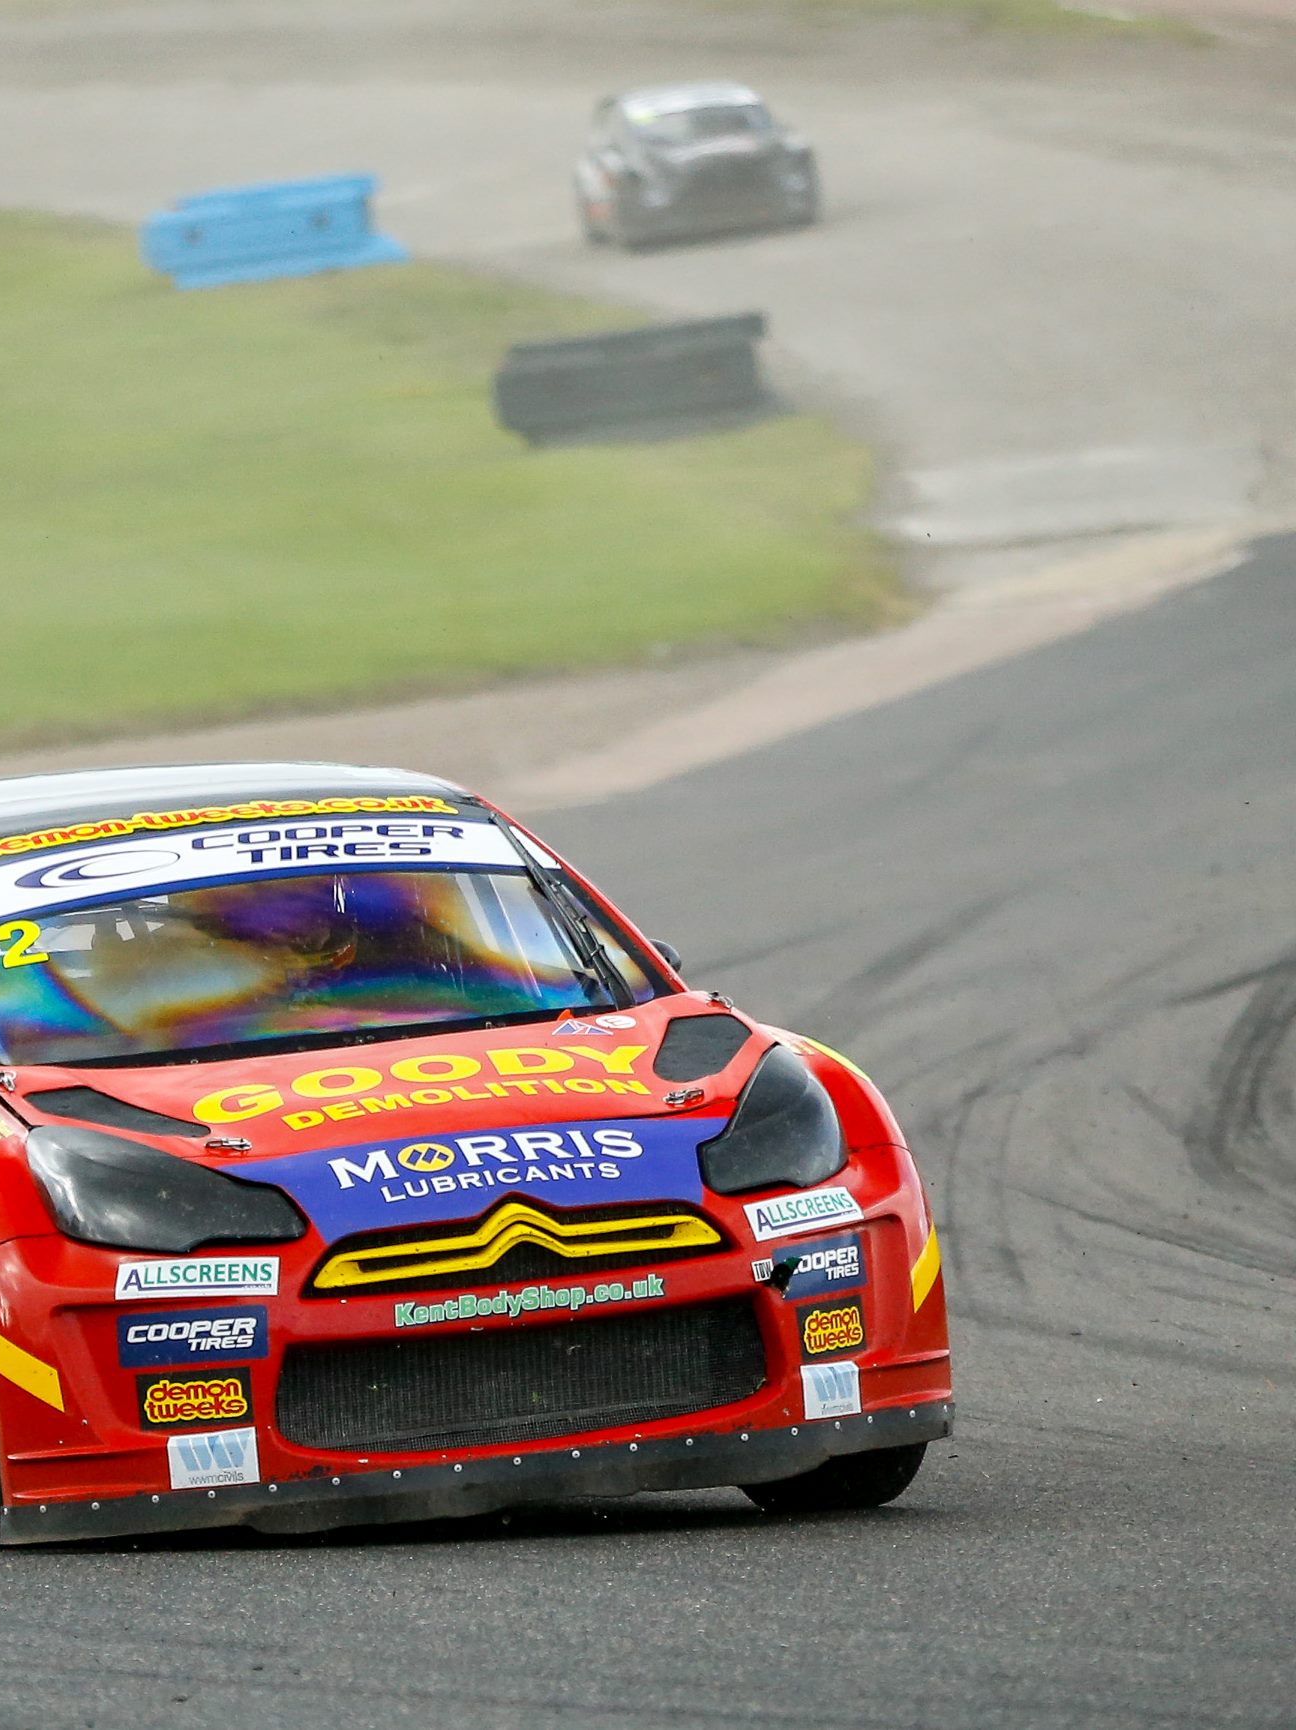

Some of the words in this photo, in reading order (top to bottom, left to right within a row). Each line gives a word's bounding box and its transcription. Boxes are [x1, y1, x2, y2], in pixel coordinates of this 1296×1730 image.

[191, 824, 465, 850] COOPER
[237, 841, 432, 864] TIRES
[192, 1045, 650, 1124] GOODY
[280, 1077, 653, 1131] DEMOLITION
[327, 1128, 644, 1190] MORRIS
[380, 1162, 623, 1203] LUBRICANTS
[756, 1193, 854, 1233] ALLSCREENS
[792, 1245, 860, 1276] OOPER
[825, 1262, 860, 1281] TIRES
[122, 1262, 274, 1292] ALLSCREENS
[394, 1273, 665, 1328] KentBodyShop.co.uk
[126, 1316, 258, 1344] COOPER
[805, 1306, 860, 1333] demon
[187, 1334, 255, 1352] TIRES
[805, 1326, 864, 1354] tweeks
[147, 1378, 243, 1403] demon
[144, 1399, 248, 1423] tweeks
